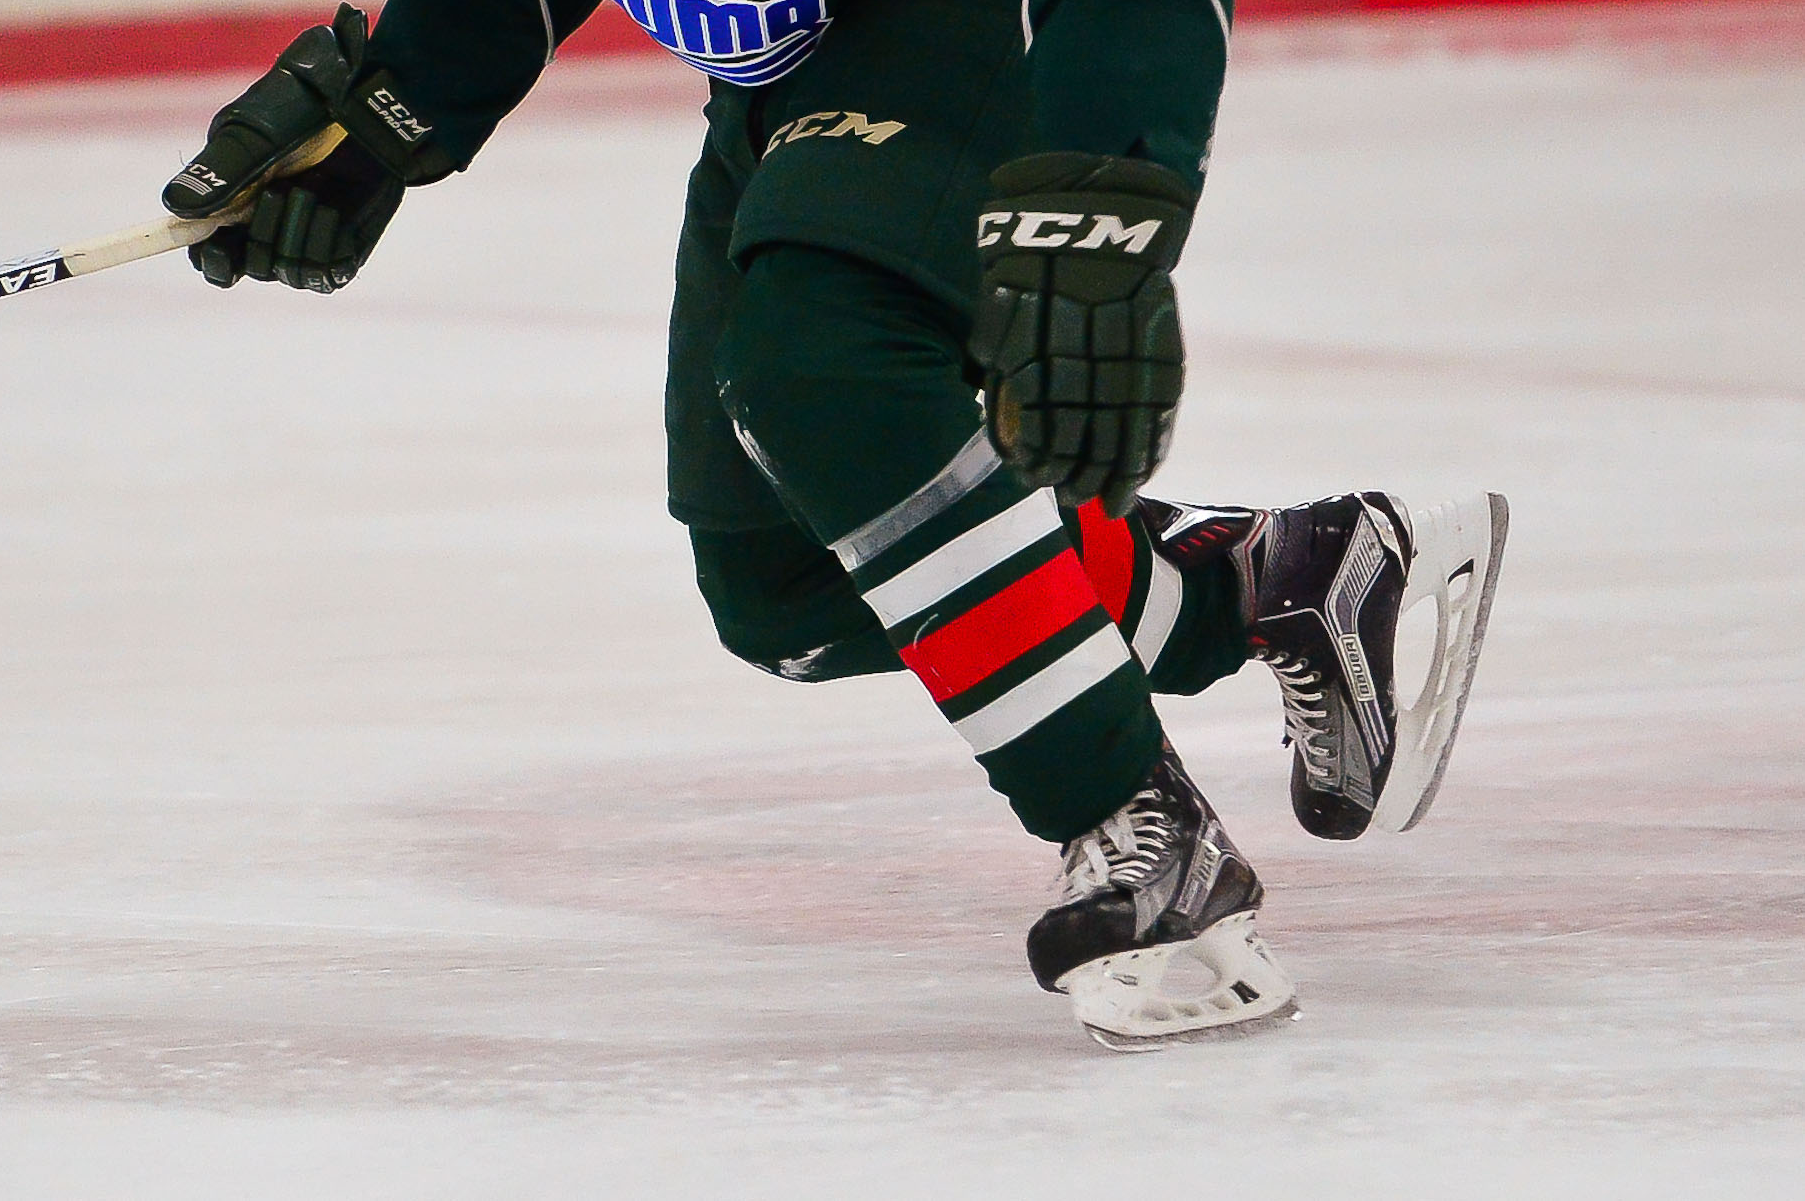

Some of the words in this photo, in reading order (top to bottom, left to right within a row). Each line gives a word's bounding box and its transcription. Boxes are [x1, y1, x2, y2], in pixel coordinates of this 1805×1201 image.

[374, 87, 433, 134] CCM
[378, 110, 401, 130] PRO
[188, 163, 228, 187] CM
[1345, 641, 1370, 695] BAUER
